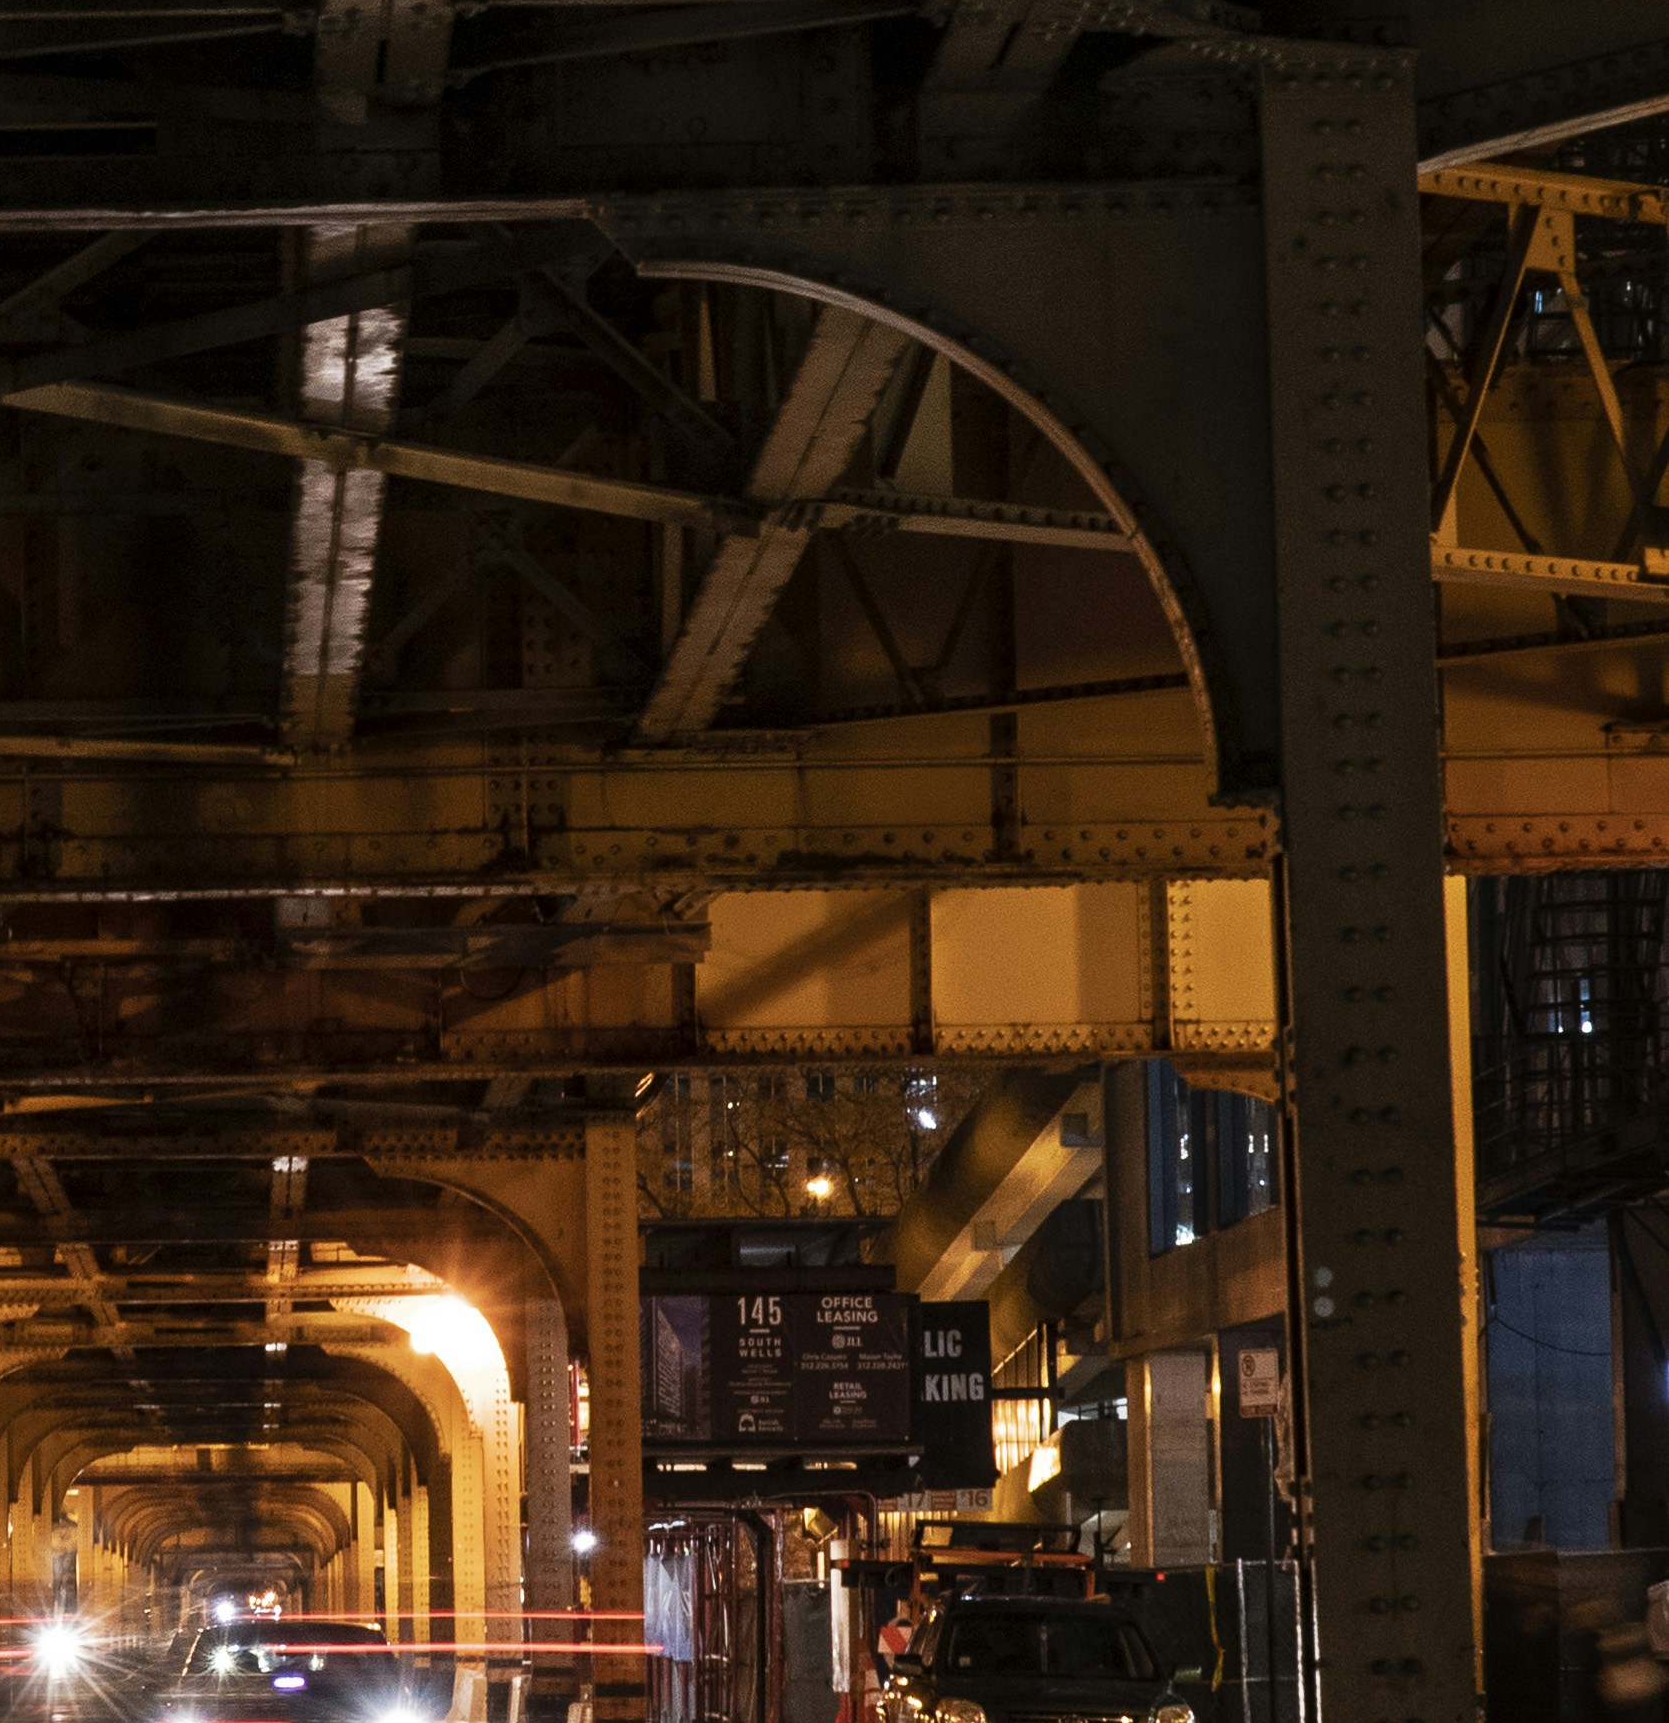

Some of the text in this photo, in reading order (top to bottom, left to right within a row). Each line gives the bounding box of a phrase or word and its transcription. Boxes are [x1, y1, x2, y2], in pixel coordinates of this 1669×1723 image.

[821, 1296, 873, 1309] OFFICE
[737, 1296, 782, 1325] 145
[816, 1310, 878, 1323] LEASING
[738, 1337, 782, 1347] SOUTH
[923, 1329, 963, 1358] LIC
[738, 1348, 782, 1358] WELLS
[833, 1382, 862, 1390] RETAIL
[924, 1373, 985, 1402] KING
[829, 1391, 867, 1400] LEASING
